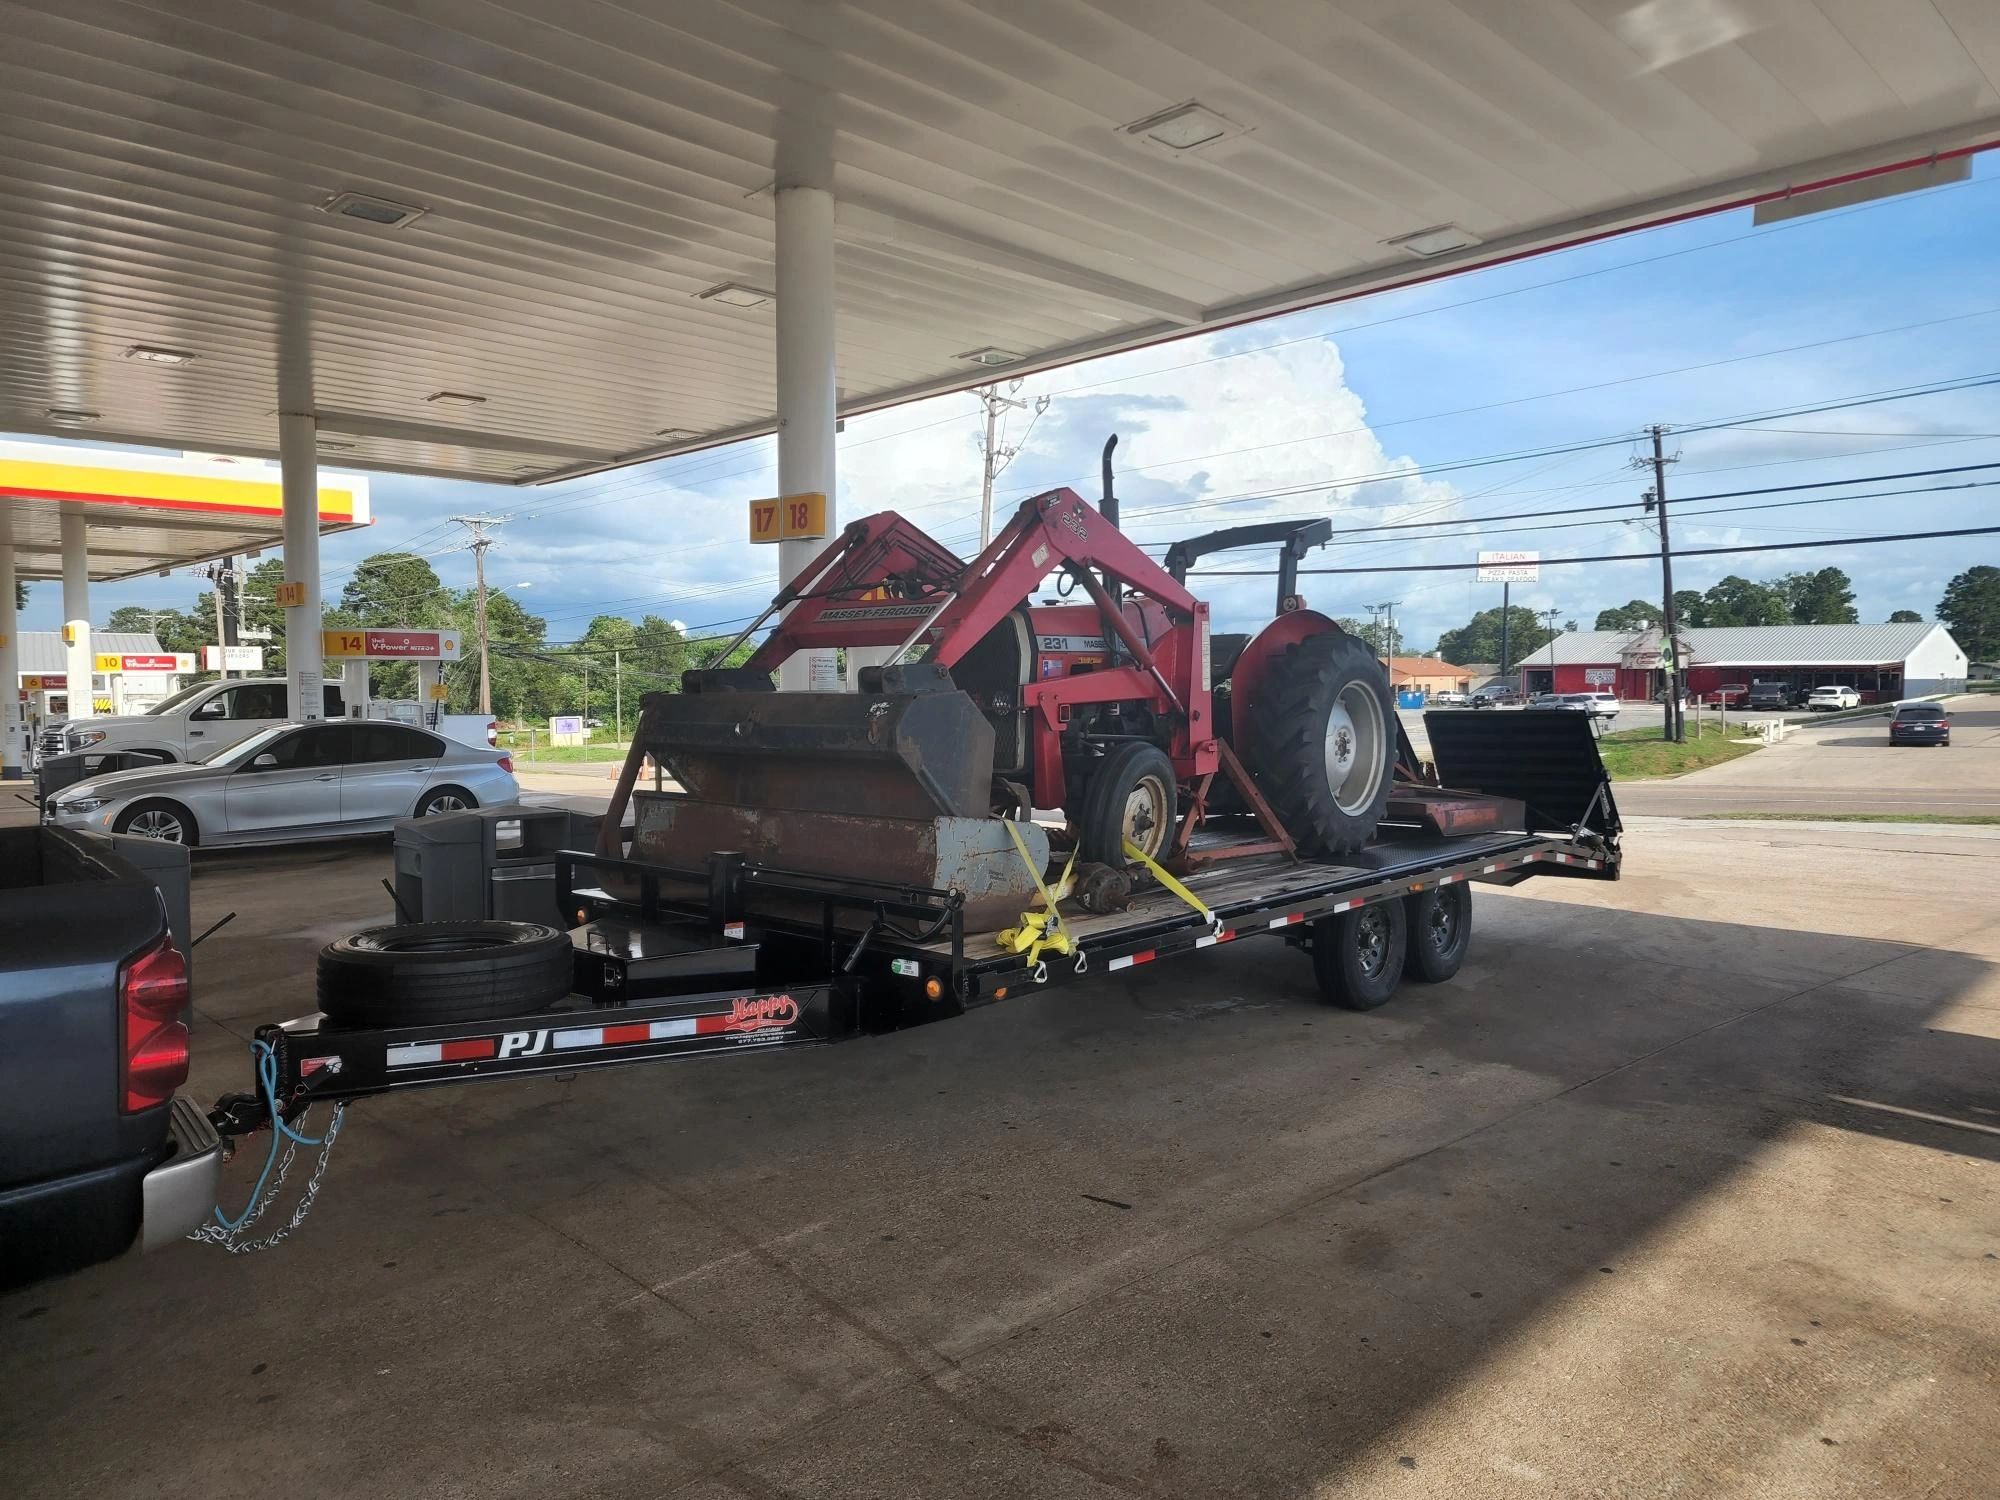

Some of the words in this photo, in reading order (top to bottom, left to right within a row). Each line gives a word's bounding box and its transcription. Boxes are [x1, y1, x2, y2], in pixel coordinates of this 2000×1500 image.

[755, 507, 775, 532] 17
[790, 503, 808, 530] 18
[1062, 511, 1088, 543] 232
[286, 586, 295, 601] 14
[820, 605, 937, 619] MASSEY-FERGUSON
[341, 636, 362, 651] 14
[372, 643, 409, 651] V-Power
[1043, 637, 1068, 650] 231
[104, 657, 118, 668] 10
[30, 678, 38, 687] 6
[725, 995, 798, 1024] Happy
[498, 1030, 548, 1058] PJ
